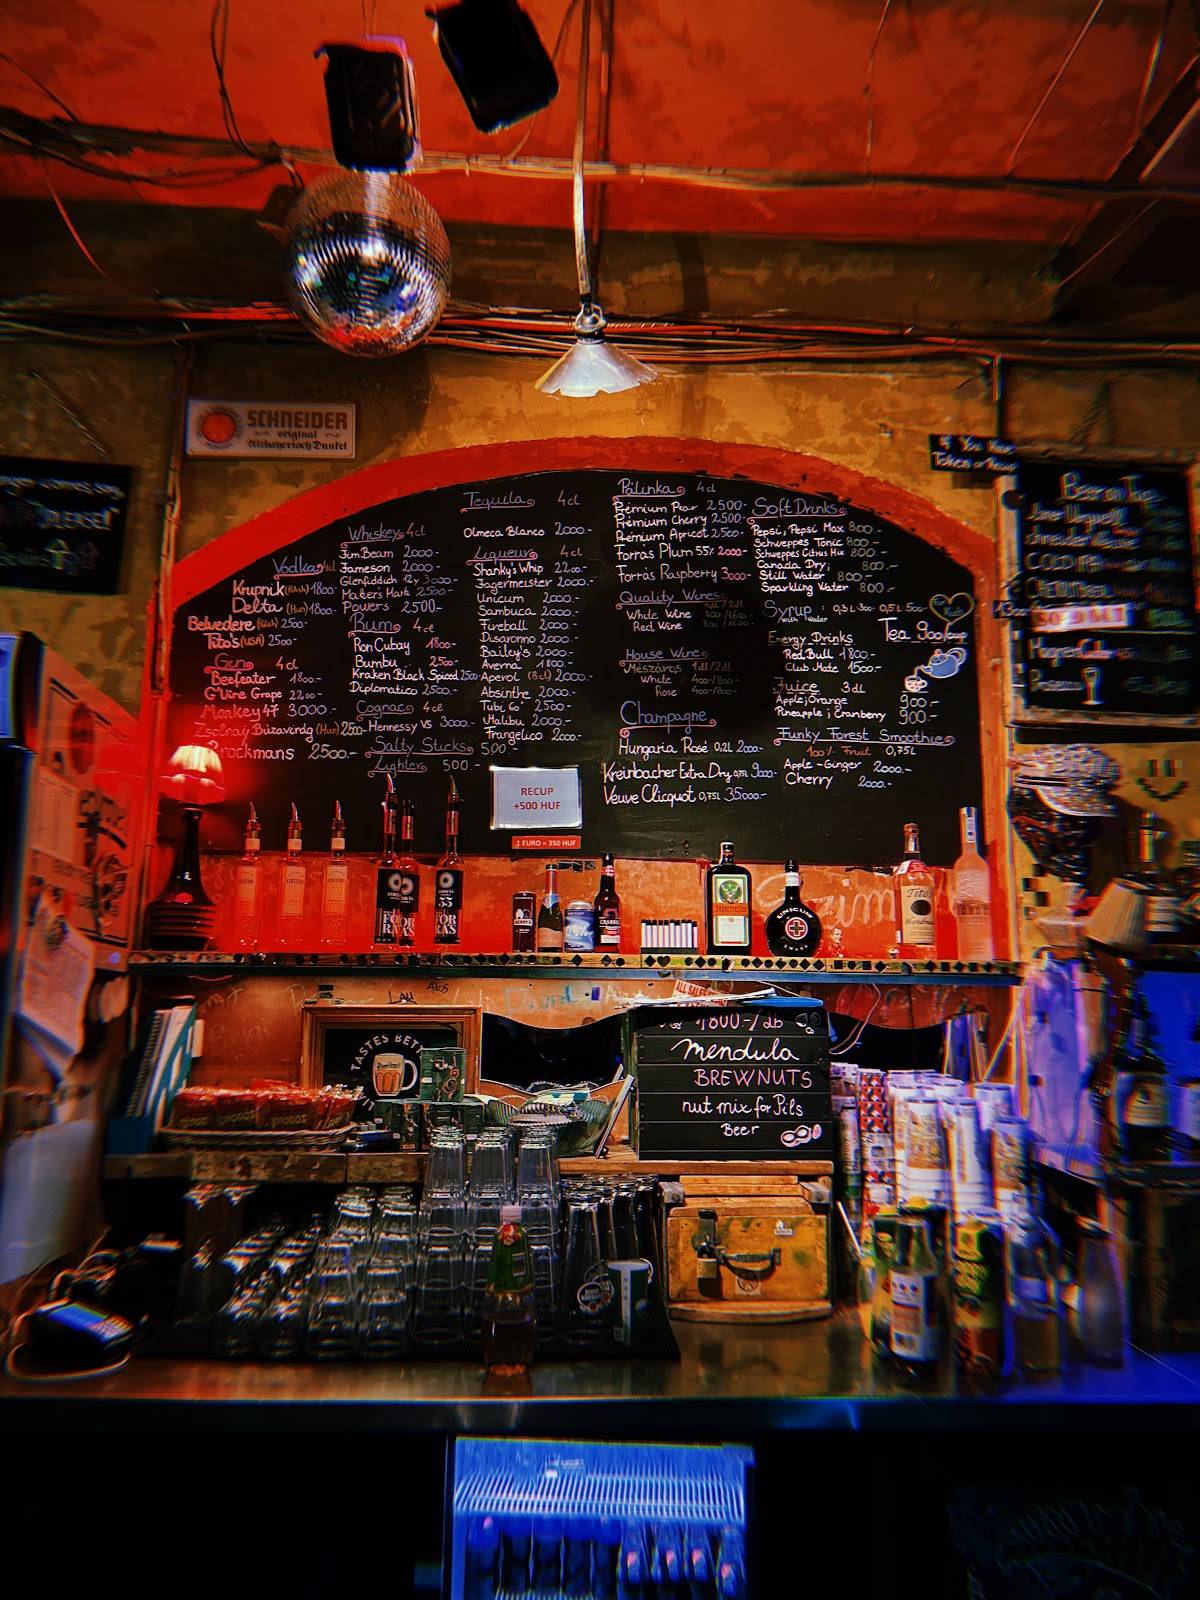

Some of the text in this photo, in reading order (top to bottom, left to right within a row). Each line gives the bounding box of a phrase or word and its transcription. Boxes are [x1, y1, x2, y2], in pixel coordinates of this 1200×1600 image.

[248, 410, 347, 429] SCHNEIDER
[462, 491, 526, 510] Tequila
[672, 501, 698, 512] Pear
[752, 497, 838, 518] Soft Drinks
[672, 515, 707, 526] Cherry
[348, 523, 400, 542] Whiskey
[464, 526, 544, 537] Olmeca Blanco
[670, 528, 709, 542] Apricot
[788, 524, 818, 536] Pepsi
[823, 522, 844, 533] Max
[754, 537, 844, 548] Schweppes Tonic
[361, 547, 393, 559] Beam
[474, 546, 533, 564] Liqueur
[659, 543, 694, 559] Plum
[755, 548, 844, 561] Schweppes Citrus Mix
[272, 555, 319, 574] Vodka
[340, 562, 390, 573] Jameson
[473, 561, 543, 578] Shanky's Whip
[757, 560, 801, 569] Canada
[340, 574, 397, 586] Glenfiddich
[660, 563, 717, 583] Raspberry
[760, 570, 825, 580] Still Water
[232, 580, 284, 600] Krupnik
[342, 587, 411, 600] Maker's Mark
[761, 582, 849, 597] Sparkling Water
[232, 597, 283, 614] Delta
[477, 593, 524, 603] Unicum
[620, 589, 720, 607] Quality Wines
[342, 601, 389, 614] Powers
[478, 605, 536, 616] Sambuca
[626, 609, 692, 620] White Wine
[763, 600, 812, 623] Syrup
[188, 615, 256, 631] Belvedere
[350, 612, 392, 630] Rum
[479, 618, 528, 631] Fireball
[633, 622, 683, 632] Red Wine
[878, 617, 911, 641] Tea
[203, 632, 240, 650] Tito's
[480, 632, 536, 643] Disaronno
[768, 631, 853, 649] Energy Drinks
[354, 637, 410, 655] Ron Cubay
[480, 644, 530, 661] Bailey's
[215, 653, 244, 669] Gin
[356, 654, 398, 668] Bumbu
[626, 649, 664, 660] House
[783, 649, 834, 660] Red Bull
[482, 660, 522, 670] Averna
[785, 662, 839, 673] Club Mate
[211, 671, 276, 687] Beefeater
[352, 668, 459, 683] Kraken Black Spiced
[480, 672, 520, 684] Aperol
[641, 675, 672, 684] White
[350, 681, 418, 695] Diplomatico
[771, 677, 819, 692] Juice
[251, 688, 282, 702] Grape
[480, 686, 531, 699] Absinthe
[200, 704, 279, 722] Monkey 47
[356, 700, 405, 719] Cognac
[480, 700, 506, 712] Tubi
[483, 714, 525, 726] Malibu
[620, 700, 707, 734] Champagne
[774, 707, 887, 722] Pineapple Cranberry
[369, 720, 418, 735] Hennessy
[484, 726, 543, 745] Frangelico
[777, 727, 944, 744] Funky Forest Smoothie
[371, 736, 466, 758] Salty Sticks
[619, 736, 708, 761] Hungaria Rosé
[841, 746, 872, 756] Fruit
[374, 756, 422, 778] Lighter
[783, 758, 813, 770] Apple
[603, 761, 733, 783] Kreinbacher Extra Dry
[785, 772, 834, 789] Cherry
[521, 788, 553, 796] RECUP
[604, 784, 697, 807] Veuve Clicquot
[513, 802, 537, 810] +500
[776, 907, 814, 920] UNICUM
[351, 1034, 424, 1071] TASTES BETT
[693, 1068, 812, 1088] BREWNUTS
[682, 1094, 803, 1118] nut mix for Pils
[721, 1123, 760, 1136] Beer
